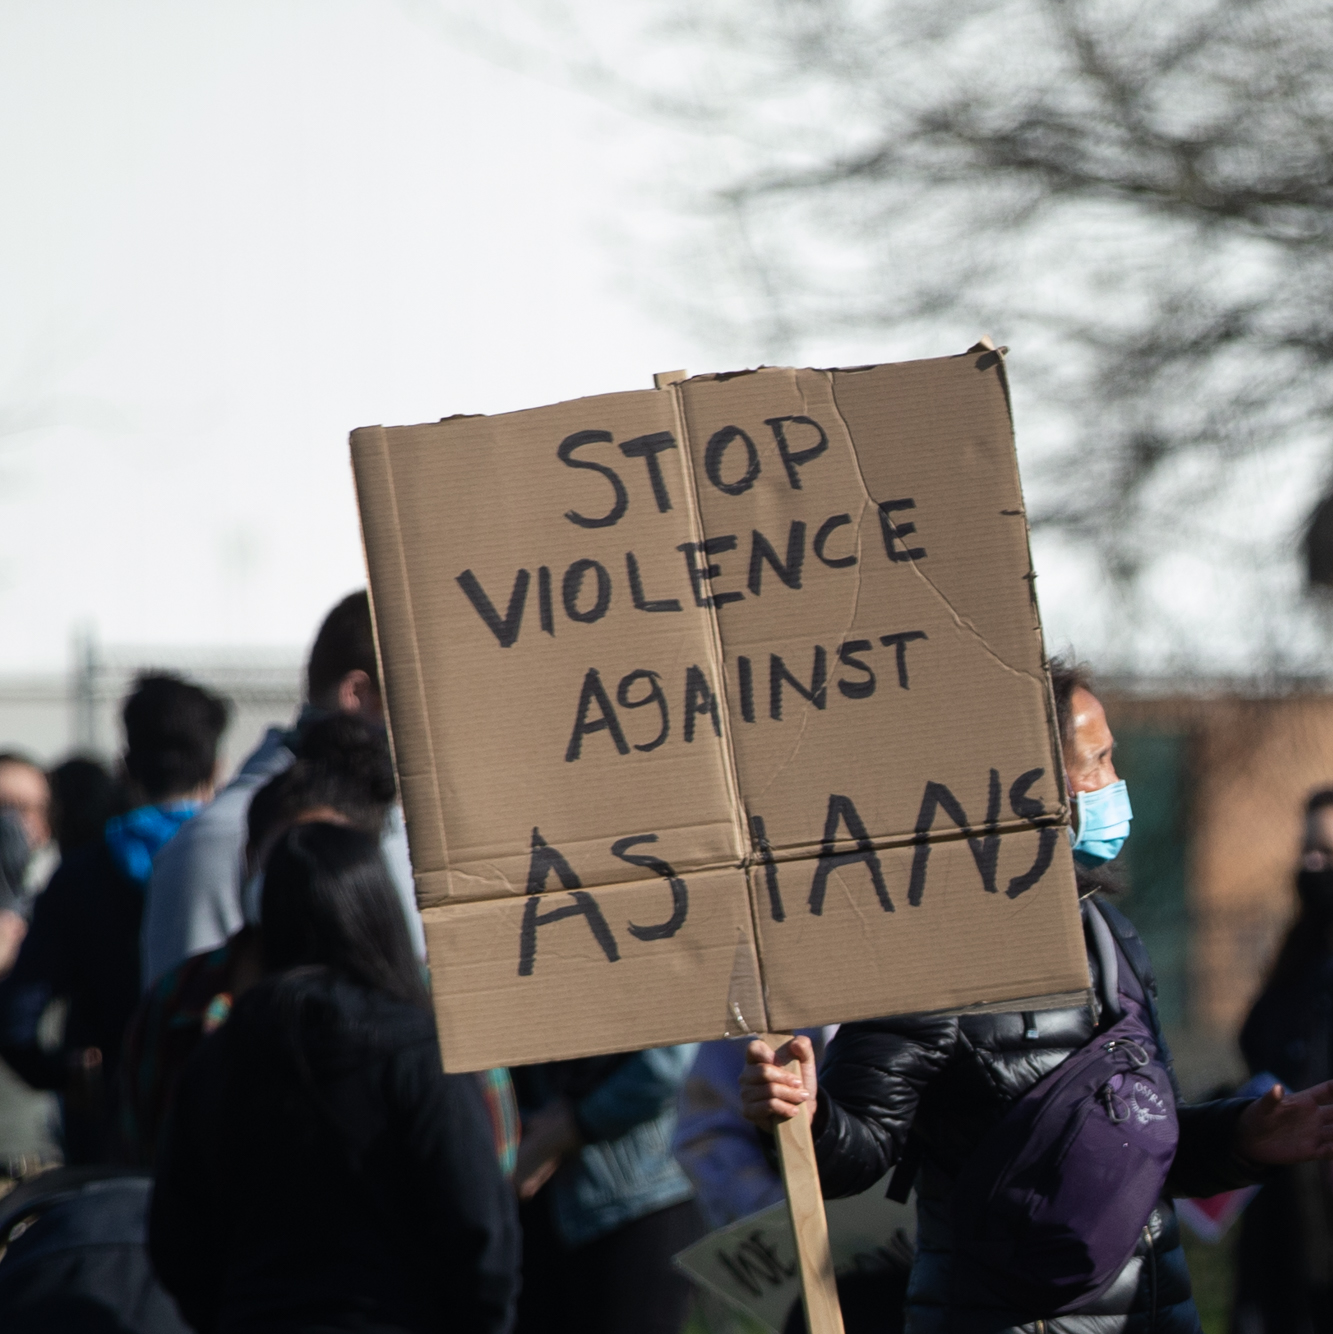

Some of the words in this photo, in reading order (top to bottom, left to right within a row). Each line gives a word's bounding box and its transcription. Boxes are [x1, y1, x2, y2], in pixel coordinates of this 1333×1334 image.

[557, 415, 829, 529] STOP
[454, 498, 928, 648] VIOLENCE
[518, 766, 1062, 977] ASIANS
